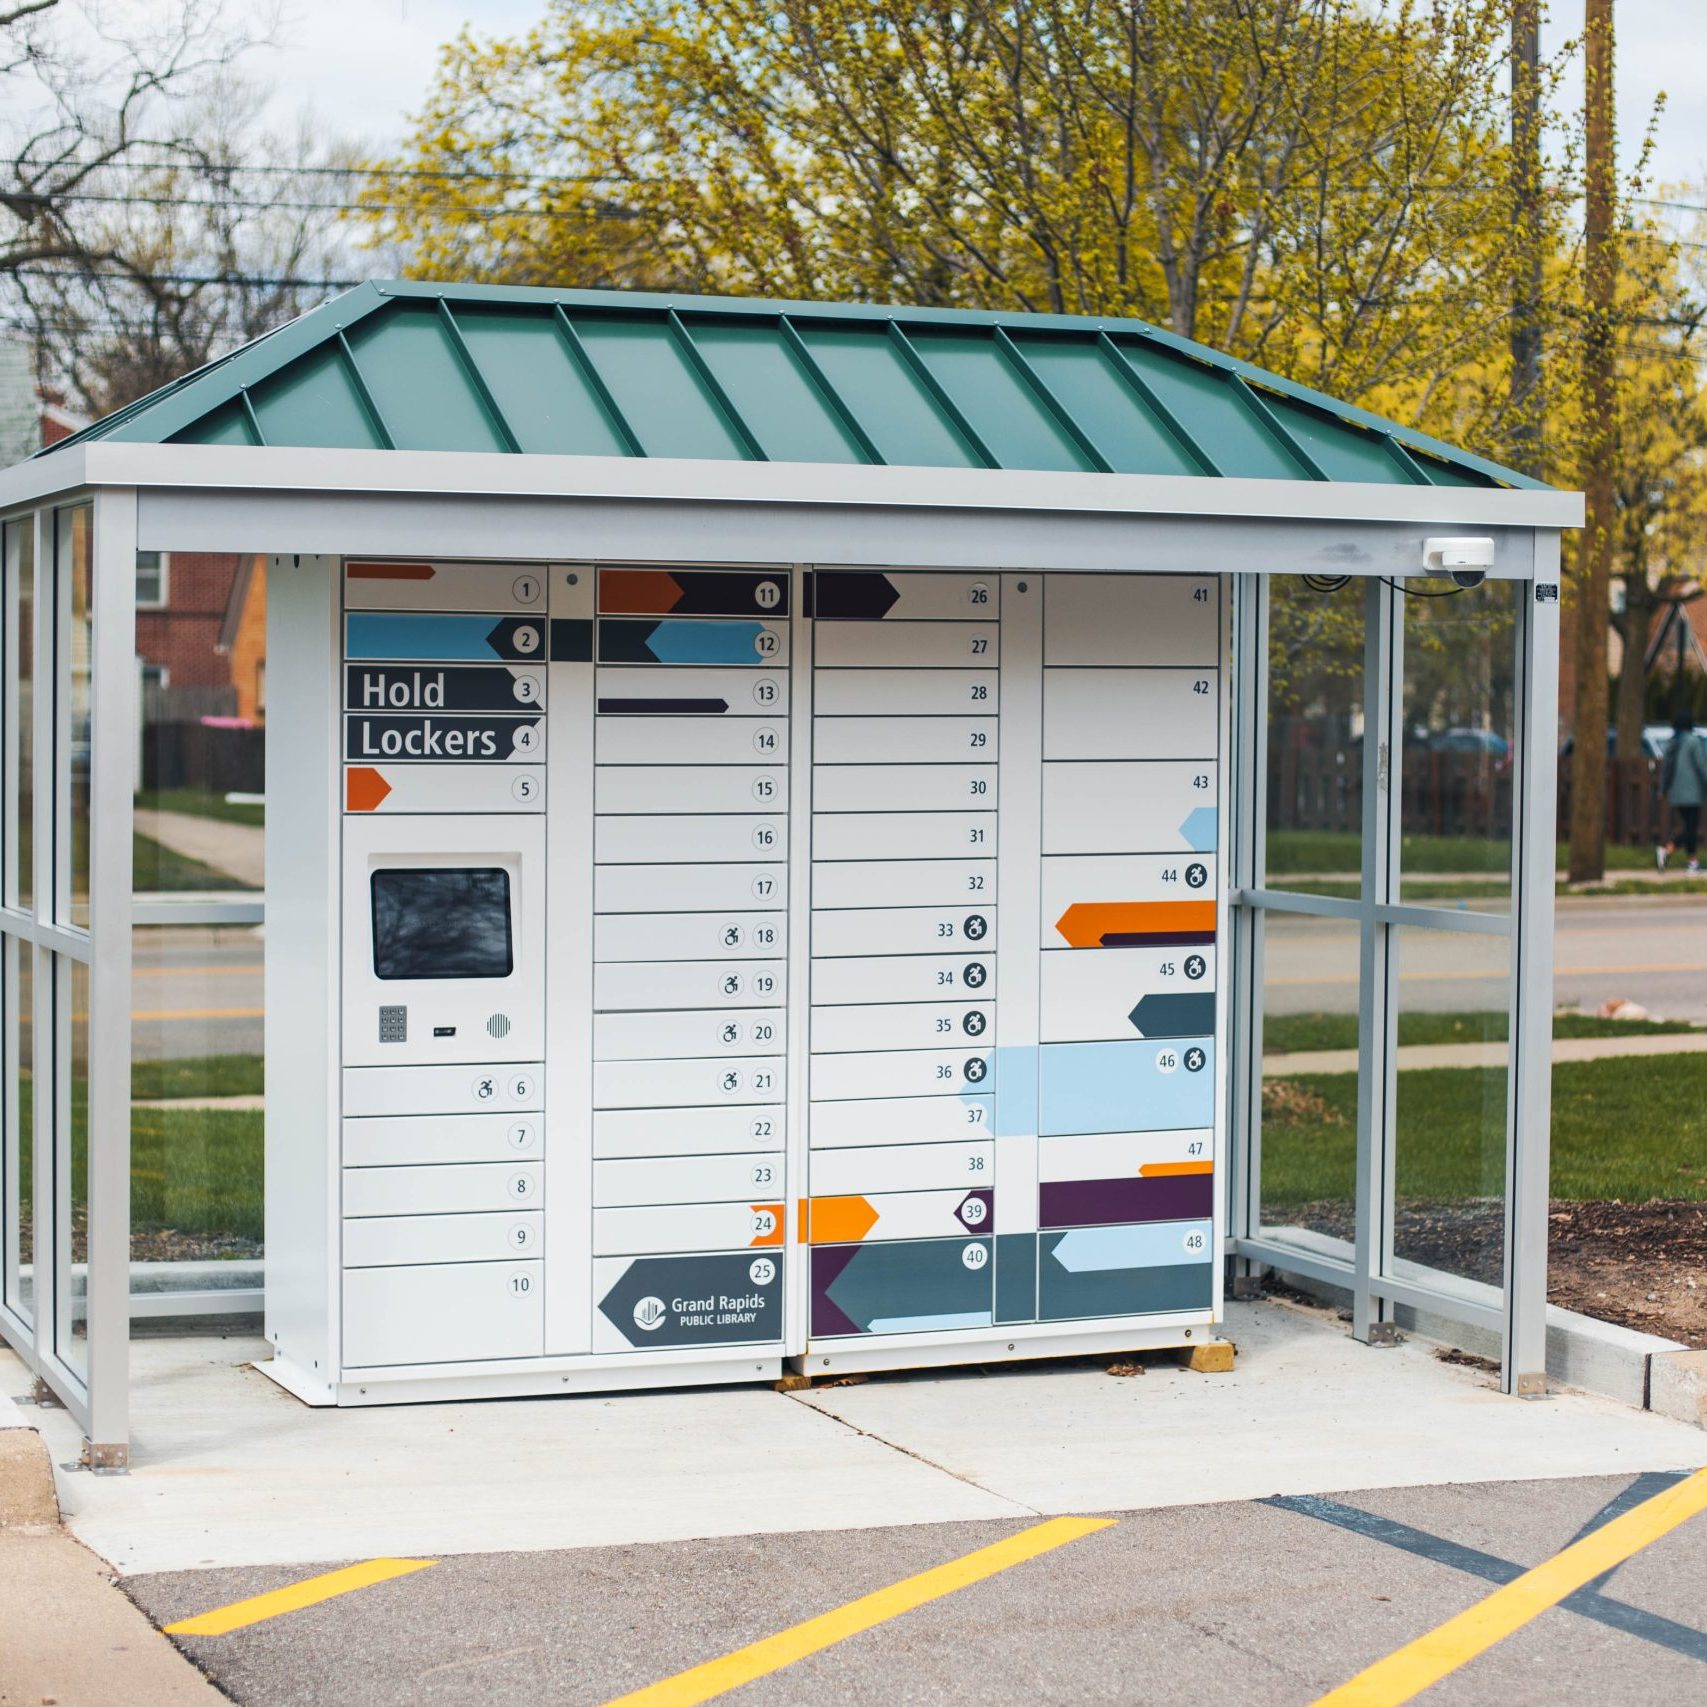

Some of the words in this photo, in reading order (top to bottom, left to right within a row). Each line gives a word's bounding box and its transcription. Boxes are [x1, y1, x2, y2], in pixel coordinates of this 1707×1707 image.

[523, 583, 530, 597] 1
[760, 588, 775, 602] 11
[971, 589, 988, 604] 26
[1193, 588, 1209, 602] 41
[521, 632, 530, 647] 2
[759, 637, 775, 651] 12
[971, 640, 988, 654] 27
[363, 672, 444, 708] Hold
[521, 682, 530, 697] 3
[759, 686, 774, 700] 13
[971, 686, 987, 700] 28
[1193, 680, 1209, 695] 42
[362, 720, 496, 755] Lockers
[521, 732, 530, 746] 4
[759, 734, 775, 748] 14
[970, 733, 986, 747] 29
[521, 782, 530, 796] 5
[757, 782, 773, 796] 15
[970, 781, 986, 795] 30
[1193, 775, 1209, 789] 43
[757, 830, 773, 845] 16
[970, 829, 984, 843] 31
[1161, 869, 1177, 882] 44
[757, 881, 773, 895] 17
[968, 876, 984, 890] 32
[758, 929, 774, 944] 18
[938, 924, 953, 937] 33
[1159, 963, 1175, 976] 45
[757, 978, 773, 992] 19
[938, 971, 953, 985] 34
[755, 1026, 772, 1040] 20
[936, 1019, 952, 1033] 35
[1159, 1054, 1175, 1068] 46
[936, 1065, 952, 1079] 36
[755, 1074, 771, 1088] 21
[517, 1081, 525, 1096] 6
[968, 1109, 983, 1123] 37
[517, 1129, 525, 1143] 7
[754, 1123, 771, 1136] 22
[1188, 1142, 1203, 1156] 47
[968, 1157, 984, 1171] 38
[755, 1168, 771, 1182] 23
[517, 1179, 526, 1193] 8
[966, 1205, 982, 1219] 39
[755, 1217, 771, 1230] 24
[517, 1230, 526, 1244] 9
[1186, 1235, 1202, 1248] 48
[967, 1250, 983, 1263] 40
[754, 1264, 771, 1279] 25
[513, 1278, 529, 1292] 10
[672, 1297, 715, 1312] Grand
[720, 1294, 765, 1313] Rapids
[680, 1315, 713, 1326] PUBLIC
[717, 1313, 756, 1325] LIBRARY
